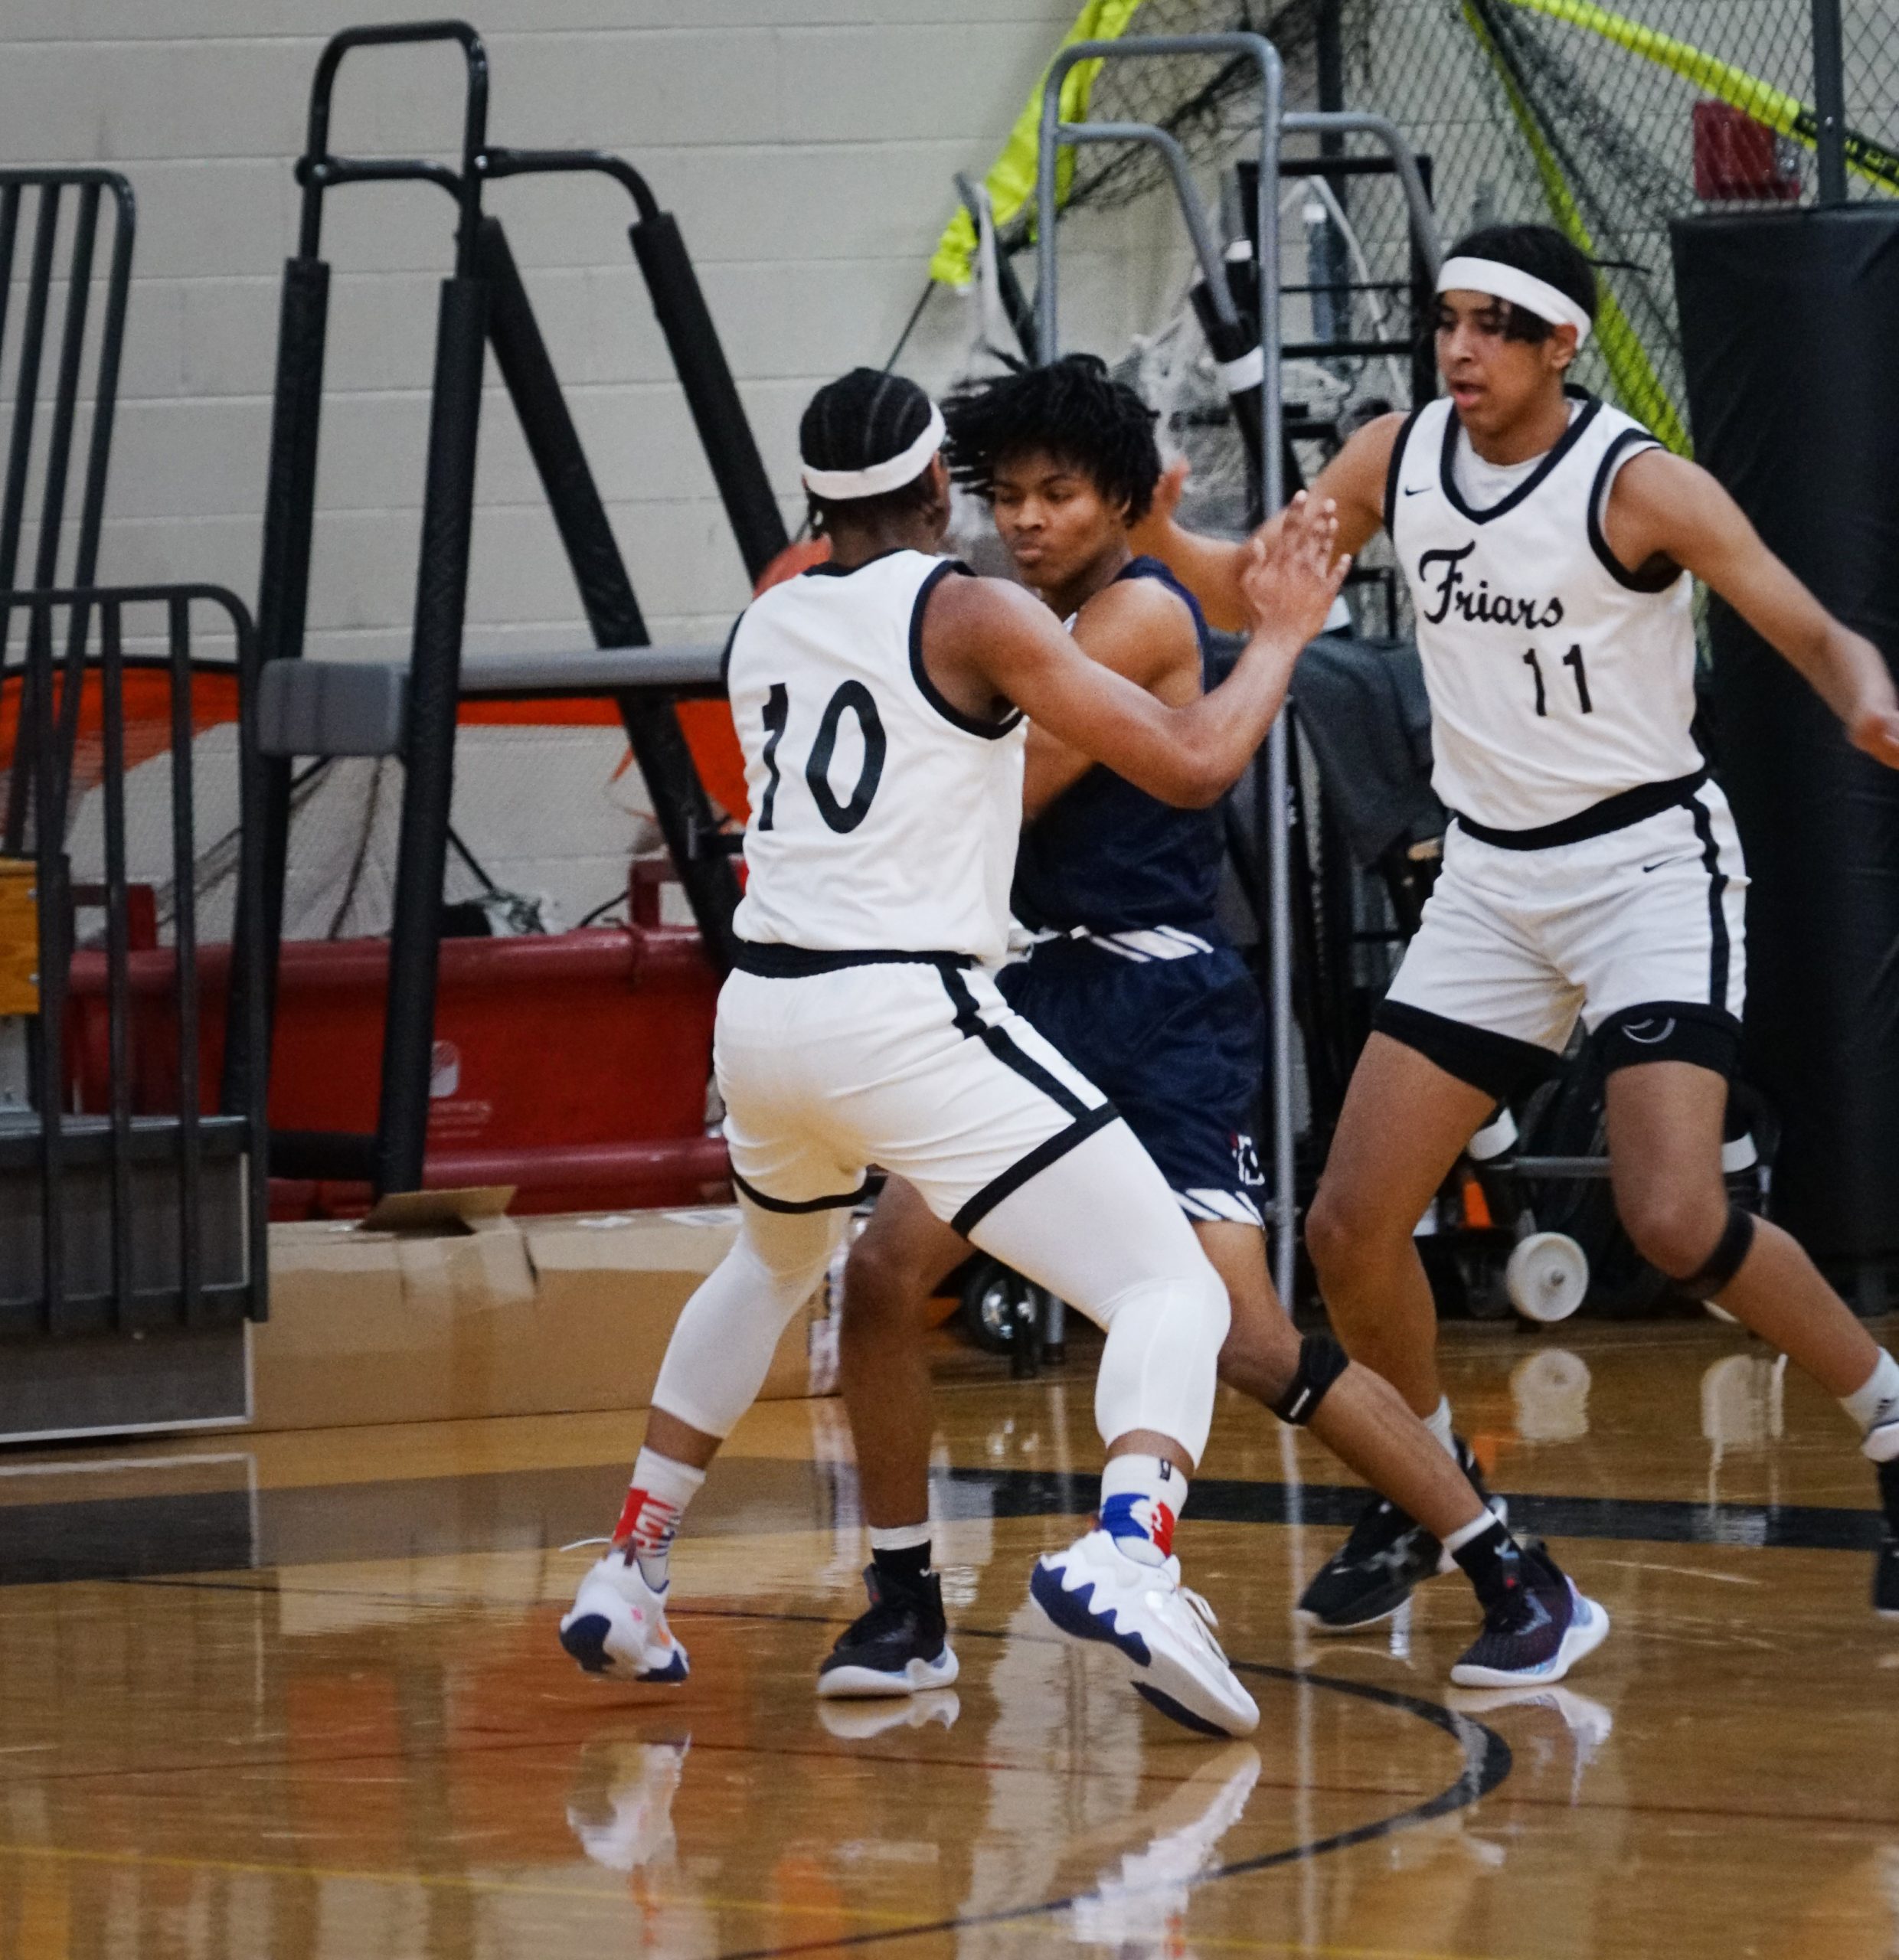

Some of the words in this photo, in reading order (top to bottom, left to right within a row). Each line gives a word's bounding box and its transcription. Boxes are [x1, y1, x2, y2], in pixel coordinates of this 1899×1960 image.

[1418, 539, 1564, 629] Friars
[1523, 644, 1593, 717] 11
[758, 679, 887, 834] 10
